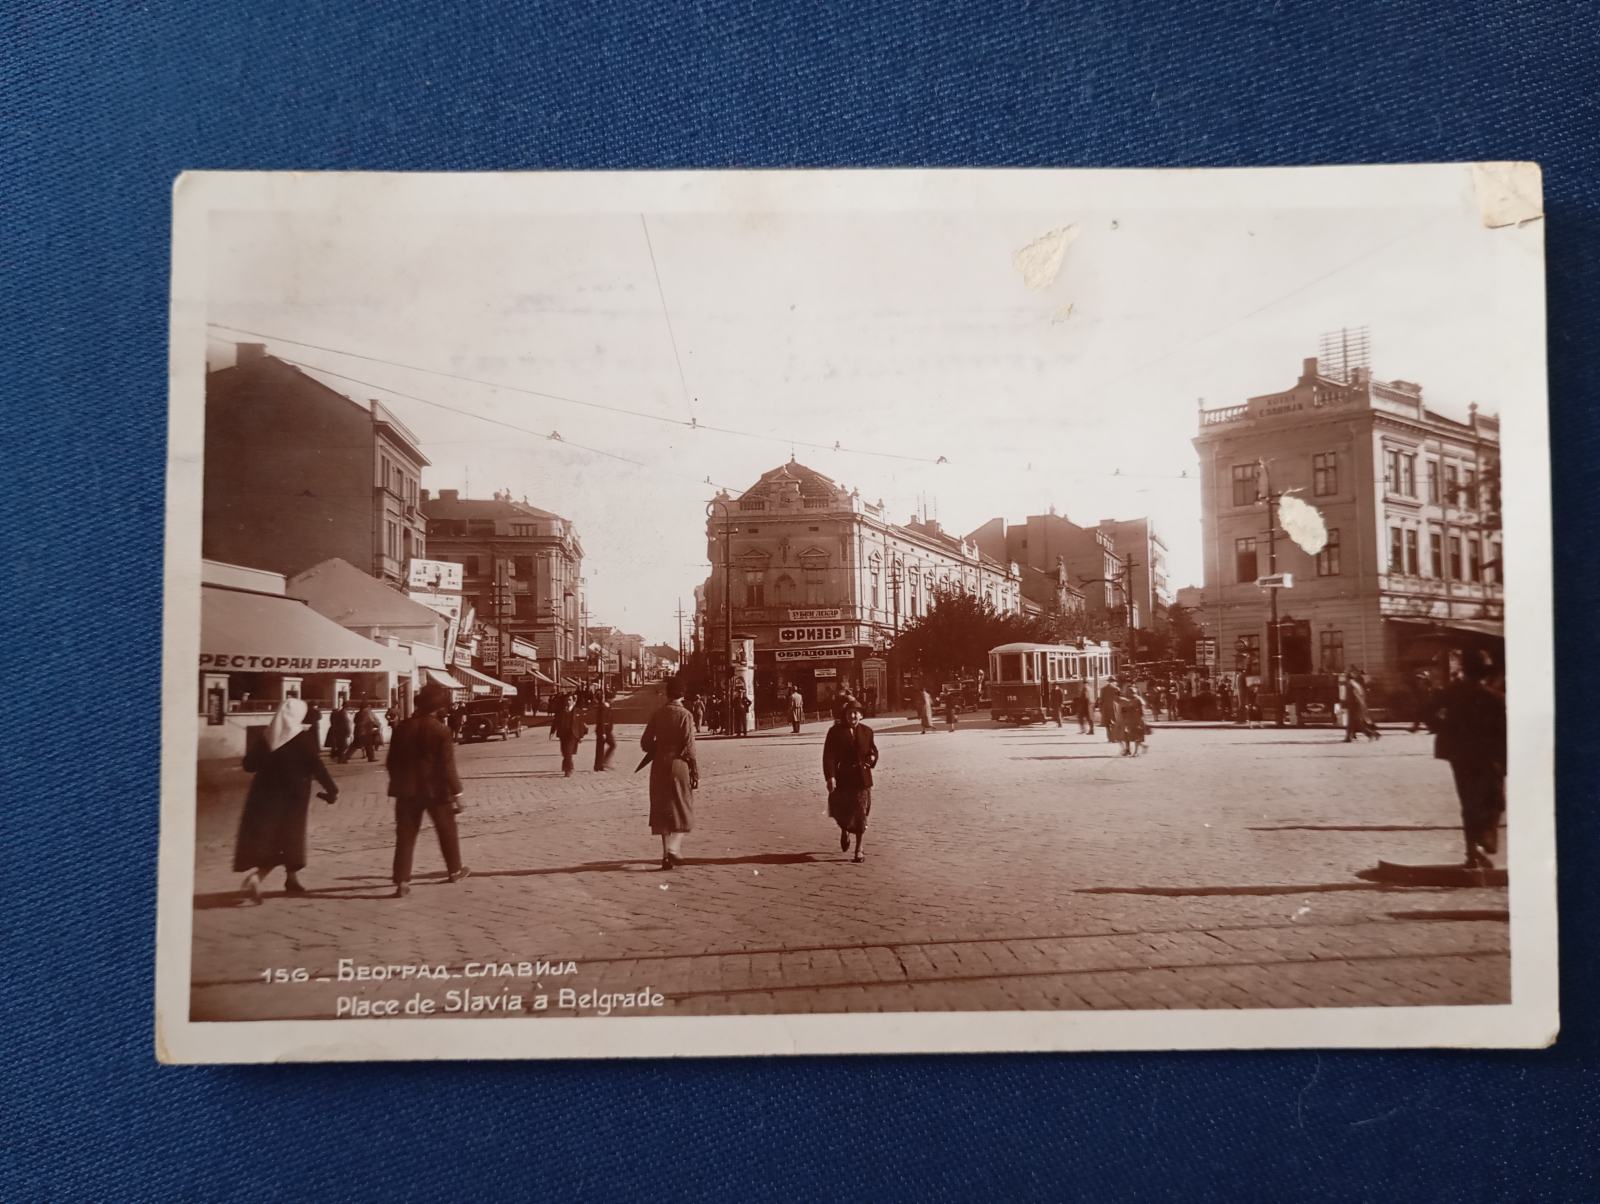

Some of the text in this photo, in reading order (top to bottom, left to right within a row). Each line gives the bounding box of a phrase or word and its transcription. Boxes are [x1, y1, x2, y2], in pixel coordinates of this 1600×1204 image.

[781, 627, 842, 641] ФРИЗЕР
[199, 653, 382, 669] РЕСТОРАН ВРАЧАР
